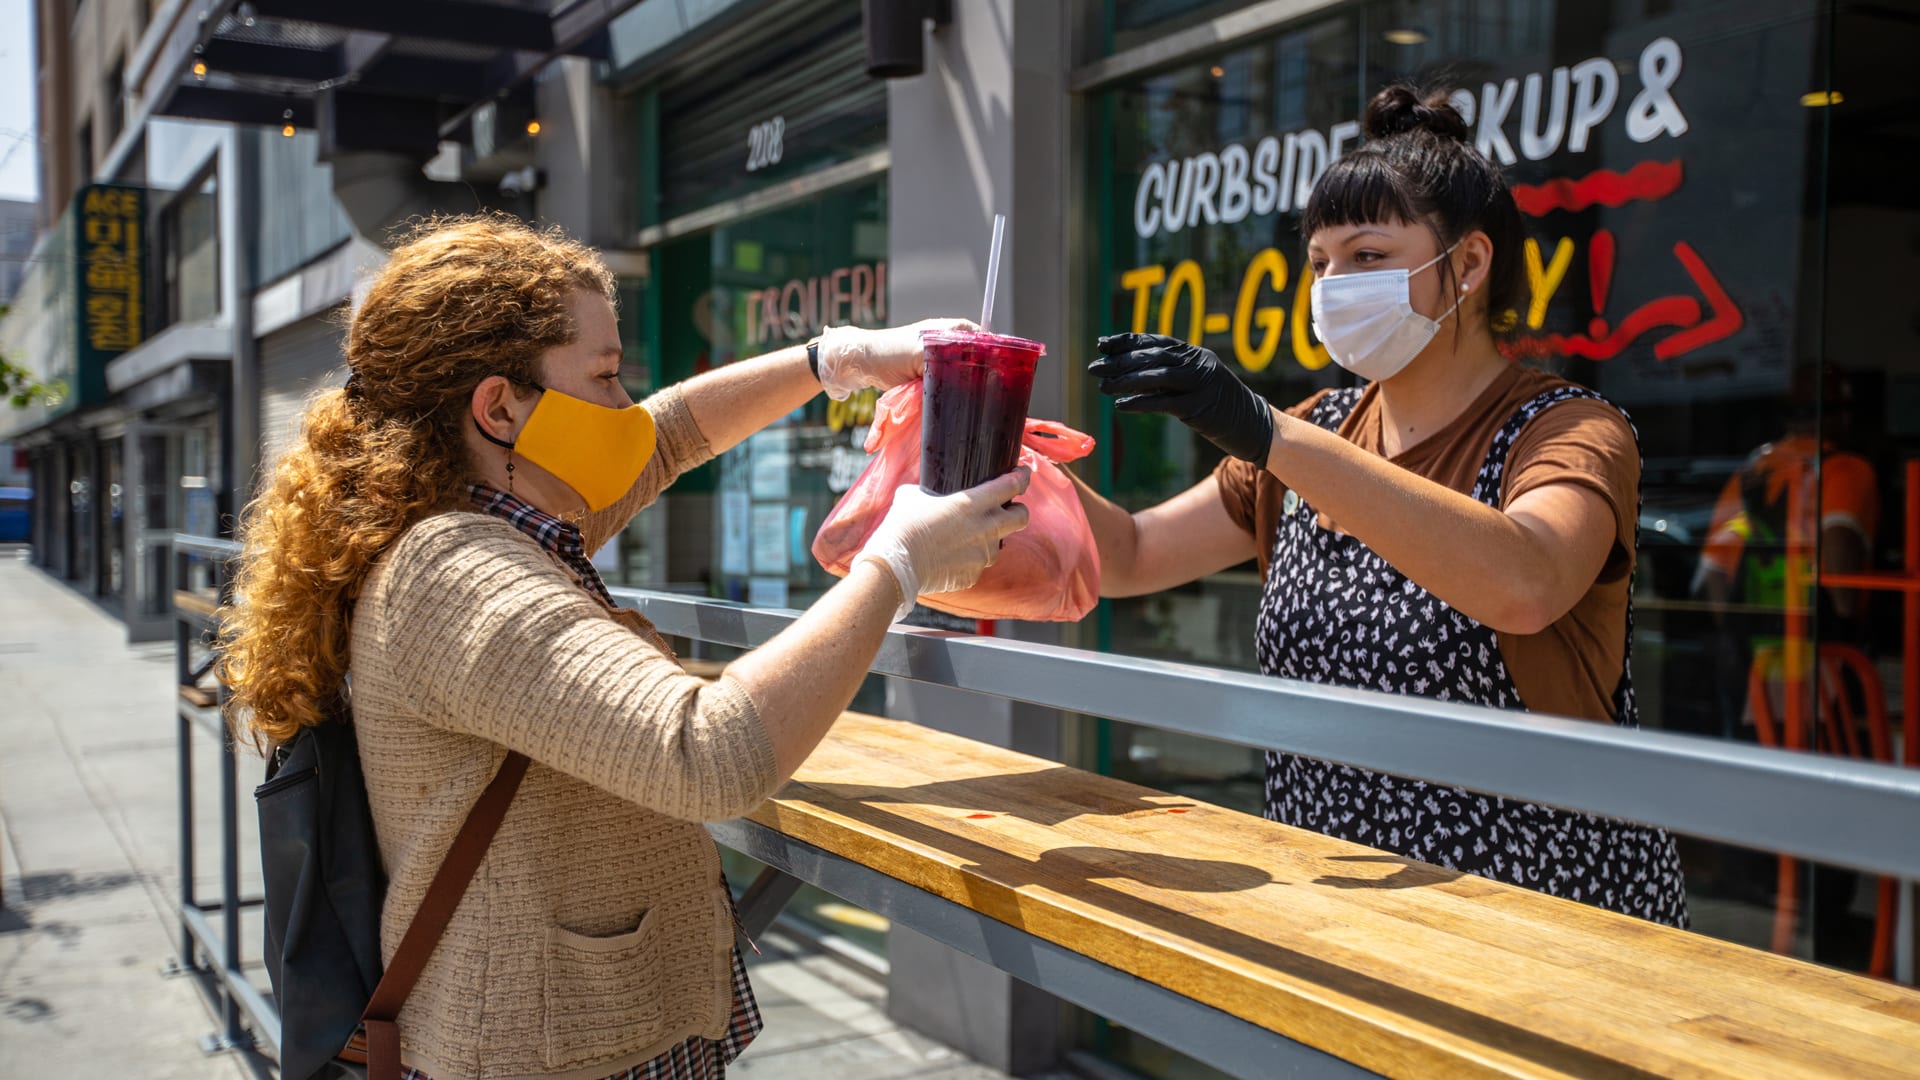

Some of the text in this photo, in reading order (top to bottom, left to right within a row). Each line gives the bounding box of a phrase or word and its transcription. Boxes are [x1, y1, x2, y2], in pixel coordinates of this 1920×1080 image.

[1446, 58, 1620, 166] KUP
[1625, 36, 1689, 143] &
[745, 262, 888, 346] TAQUERI
